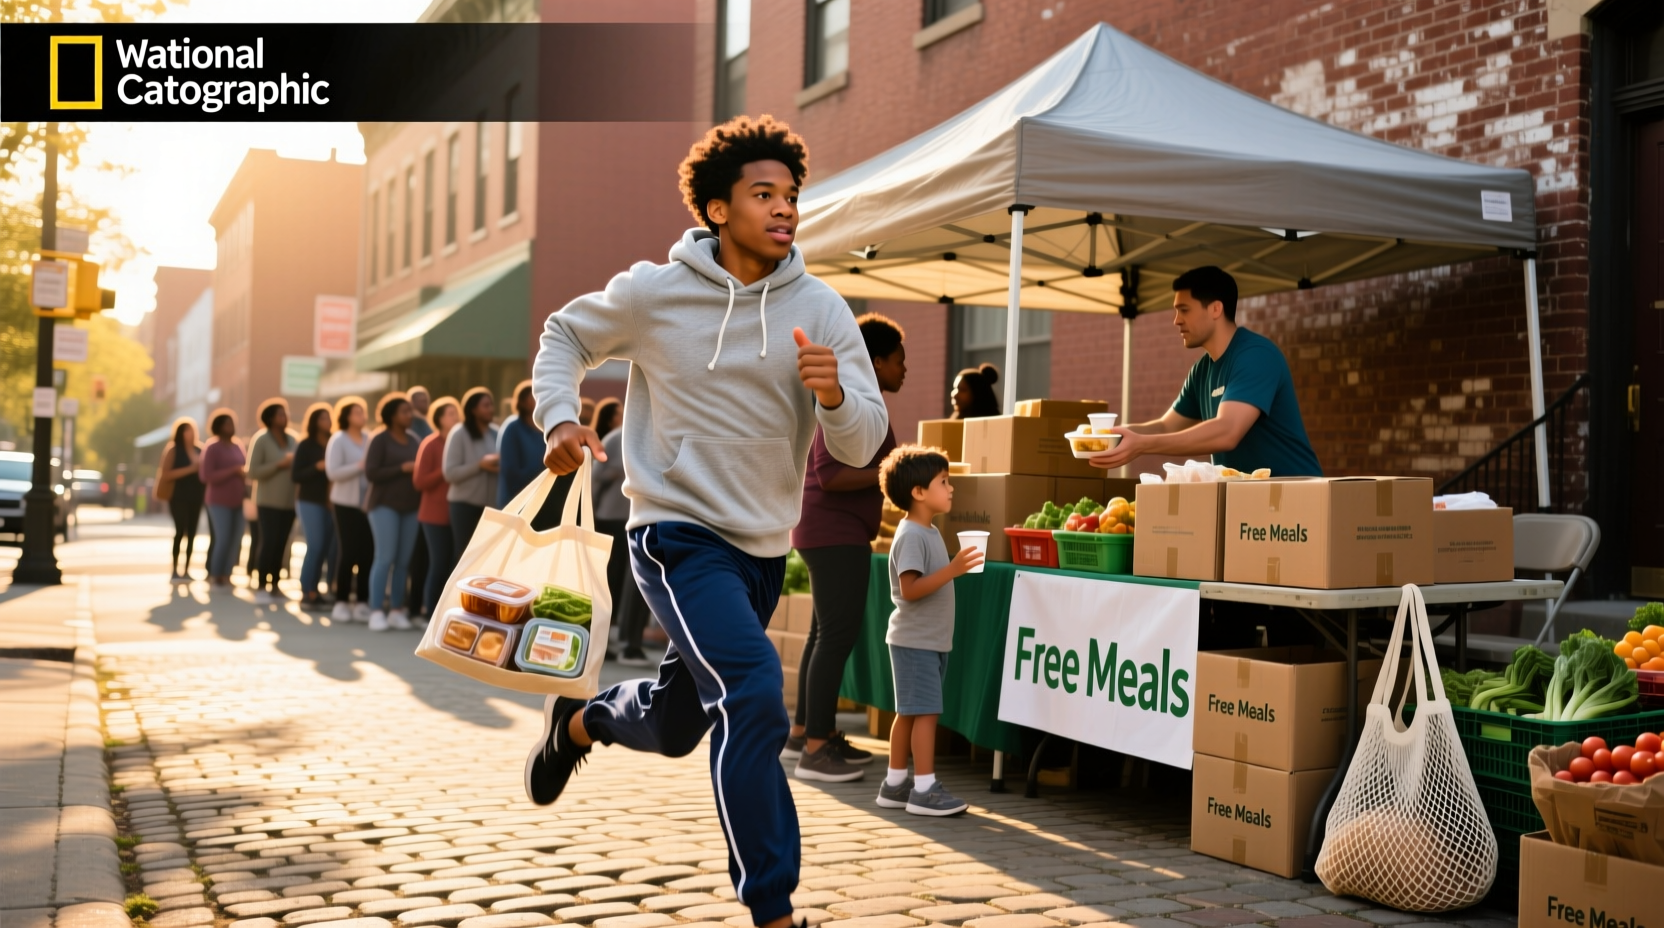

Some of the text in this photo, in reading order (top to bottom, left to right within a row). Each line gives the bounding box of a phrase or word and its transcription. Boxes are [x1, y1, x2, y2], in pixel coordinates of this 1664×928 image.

[1239, 522, 1308, 543] Free Meals
[1014, 626, 1190, 718] Free Meals
[1208, 693, 1276, 723] Free Meals
[1207, 796, 1272, 829] Free Meals
[1547, 895, 1586, 926] Free
